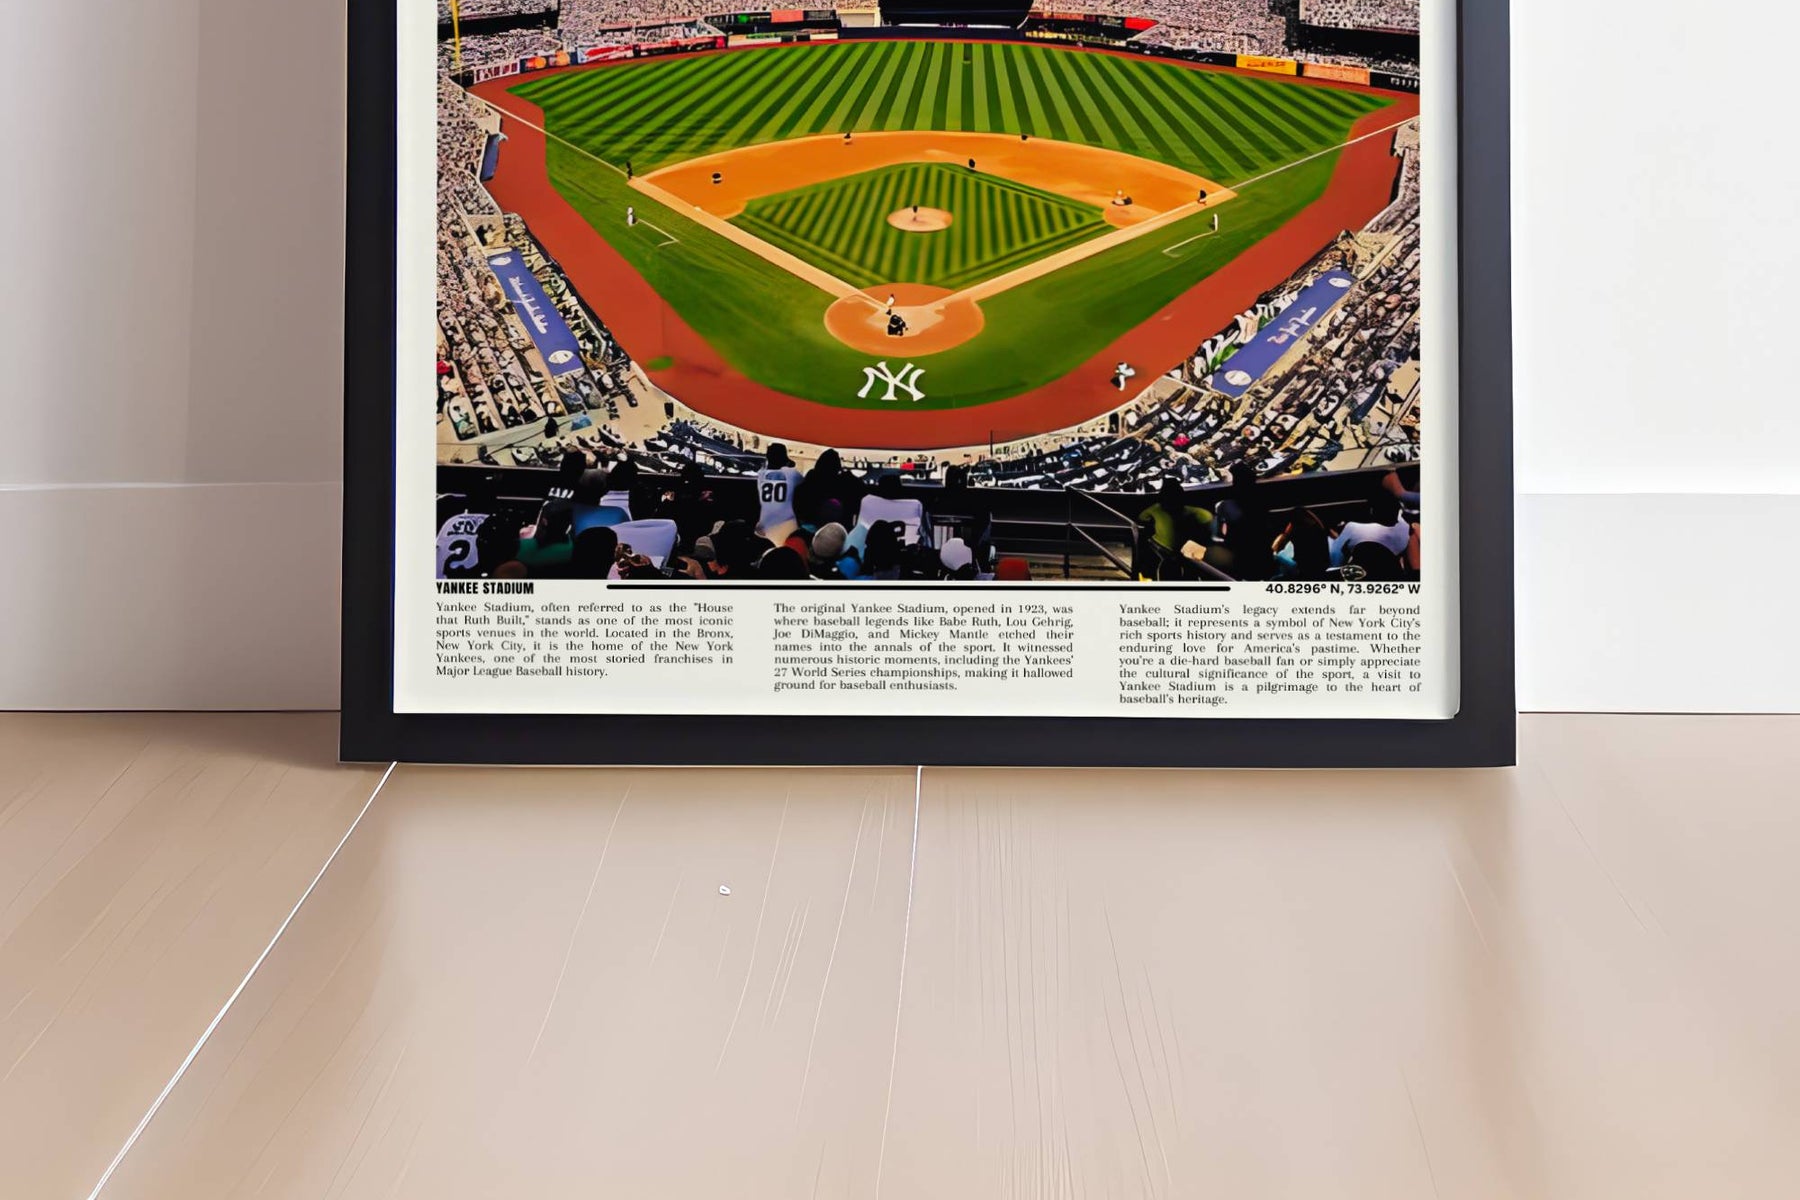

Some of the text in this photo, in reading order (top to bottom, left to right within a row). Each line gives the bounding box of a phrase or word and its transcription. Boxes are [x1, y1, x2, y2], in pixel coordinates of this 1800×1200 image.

[436, 582, 534, 594] YANKEE STADIUM
[1330, 583, 1344, 595] N,
[1408, 583, 1421, 594] W
[436, 602, 477, 612] Yankee
[484, 602, 534, 614] Stadium,
[541, 602, 570, 612] often
[578, 602, 624, 612] referred
[632, 604, 642, 612] to
[669, 602, 687, 612] the
[773, 603, 796, 613] The
[801, 603, 845, 616] original
[851, 603, 892, 613] Yankee
[897, 603, 948, 614] Stadium,
[953, 603, 995, 616] opened
[1001, 603, 1012, 613] in
[1019, 603, 1047, 614] 1923,
[1119, 604, 1161, 614] Yankee
[1243, 604, 1278, 617] legacy
[1291, 604, 1335, 614] extends
[1349, 604, 1366, 614] far
[1379, 604, 1420, 617] beyond
[774, 616, 1073, 629] where baseball legends like Babe Ruth, Lou Gehrig,
[1120, 617, 1169, 628] baseball;
[1175, 617, 1182, 627] it
[1188, 618, 1249, 630] represents
[1266, 617, 1306, 630] symbol
[1312, 617, 1325, 627] of
[1329, 617, 1353, 627] New
[1358, 617, 1385, 627] York
[436, 628, 733, 640] sports venues in the world. Located in the Bronx,
[772, 629, 1074, 642] Joe DiMaggio, and Mickey Mantle etched their
[436, 640, 733, 653] New York City, it is the home of the New York
[775, 642, 1073, 654] names into the annals of the sport. It witnessed
[1119, 642, 1173, 656] enduring
[1183, 642, 1206, 653] love
[1217, 642, 1234, 653] for
[1311, 642, 1359, 656] pastime.
[1370, 642, 1421, 653] Whether
[436, 653, 485, 664] Yankees,
[523, 653, 536, 663] of
[543, 653, 560, 663] the
[570, 654, 597, 663] most
[606, 653, 645, 663] storied
[654, 653, 713, 663] franchises
[722, 653, 733, 663] in
[837, 654, 880, 664] historic
[885, 656, 940, 666] moments,
[945, 654, 1000, 667] including
[1003, 654, 1020, 664] the
[1170, 655, 1219, 666] die-hard
[1224, 655, 1271, 666] baseball
[1276, 655, 1294, 666] fan
[1300, 658, 1313, 666] or
[1317, 655, 1356, 668] simply
[1360, 655, 1421, 668] appreciate
[436, 666, 608, 678] Major League Baseball history.
[774, 667, 1073, 680] 27 World Series championships, making it hallowed
[1119, 668, 1137, 678] the
[1145, 668, 1190, 678] cultural
[1198, 668, 1268, 681] significance
[1276, 668, 1289, 678] of
[1296, 668, 1314, 678] the
[1322, 670, 1354, 681] sport,
[1375, 668, 1401, 678] visit
[1410, 670, 1421, 678] to
[1119, 681, 1161, 691] Yankee
[1168, 681, 1216, 691] Stadium
[1225, 681, 1234, 691] is
[1256, 681, 1318, 694] pilgrimage
[1326, 683, 1337, 691] to
[1345, 681, 1363, 691] the
[1372, 681, 1401, 691] heart
[1409, 681, 1422, 691] of
[1178, 694, 1227, 707] heritage.
